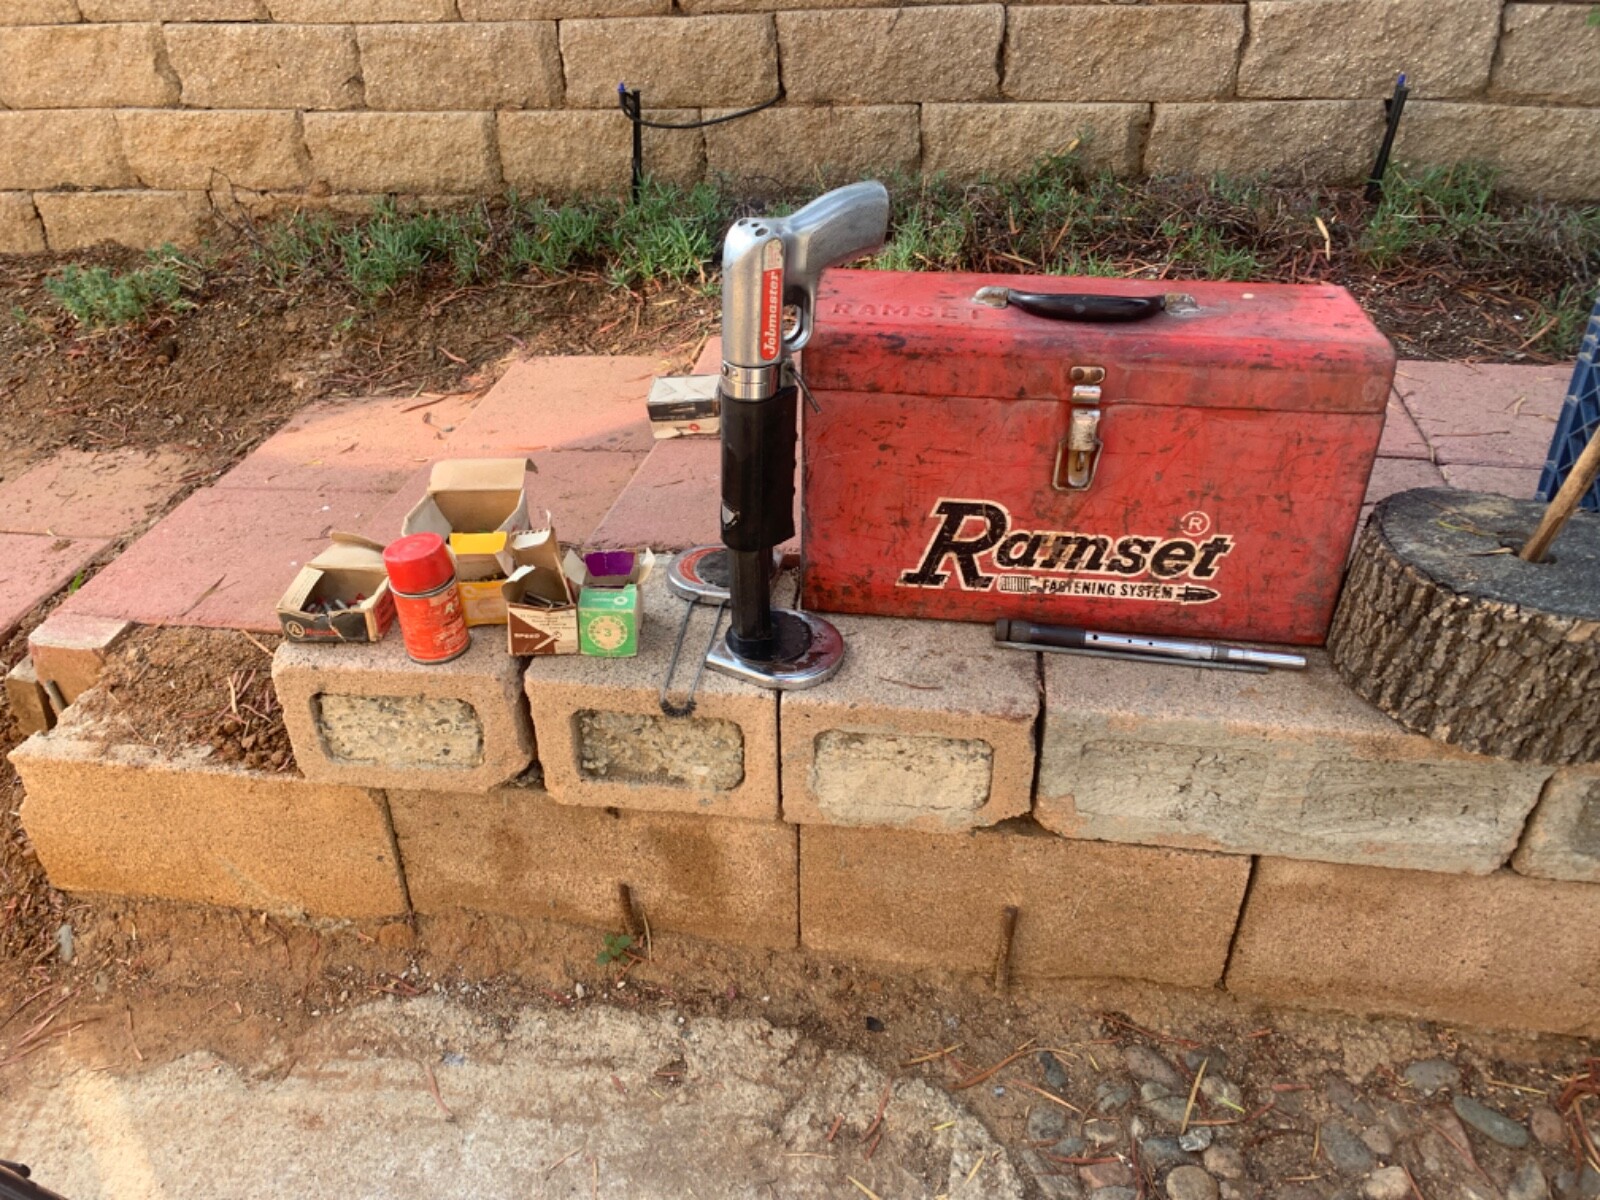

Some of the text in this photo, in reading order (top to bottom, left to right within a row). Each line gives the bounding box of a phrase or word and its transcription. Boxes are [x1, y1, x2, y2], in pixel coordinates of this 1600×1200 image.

[763, 271, 780, 355] Jobmaster
[832, 302, 984, 320] RAMSET
[896, 498, 1234, 591] Ramset
[1042, 578, 1174, 600] FASTENING SYSTEM
